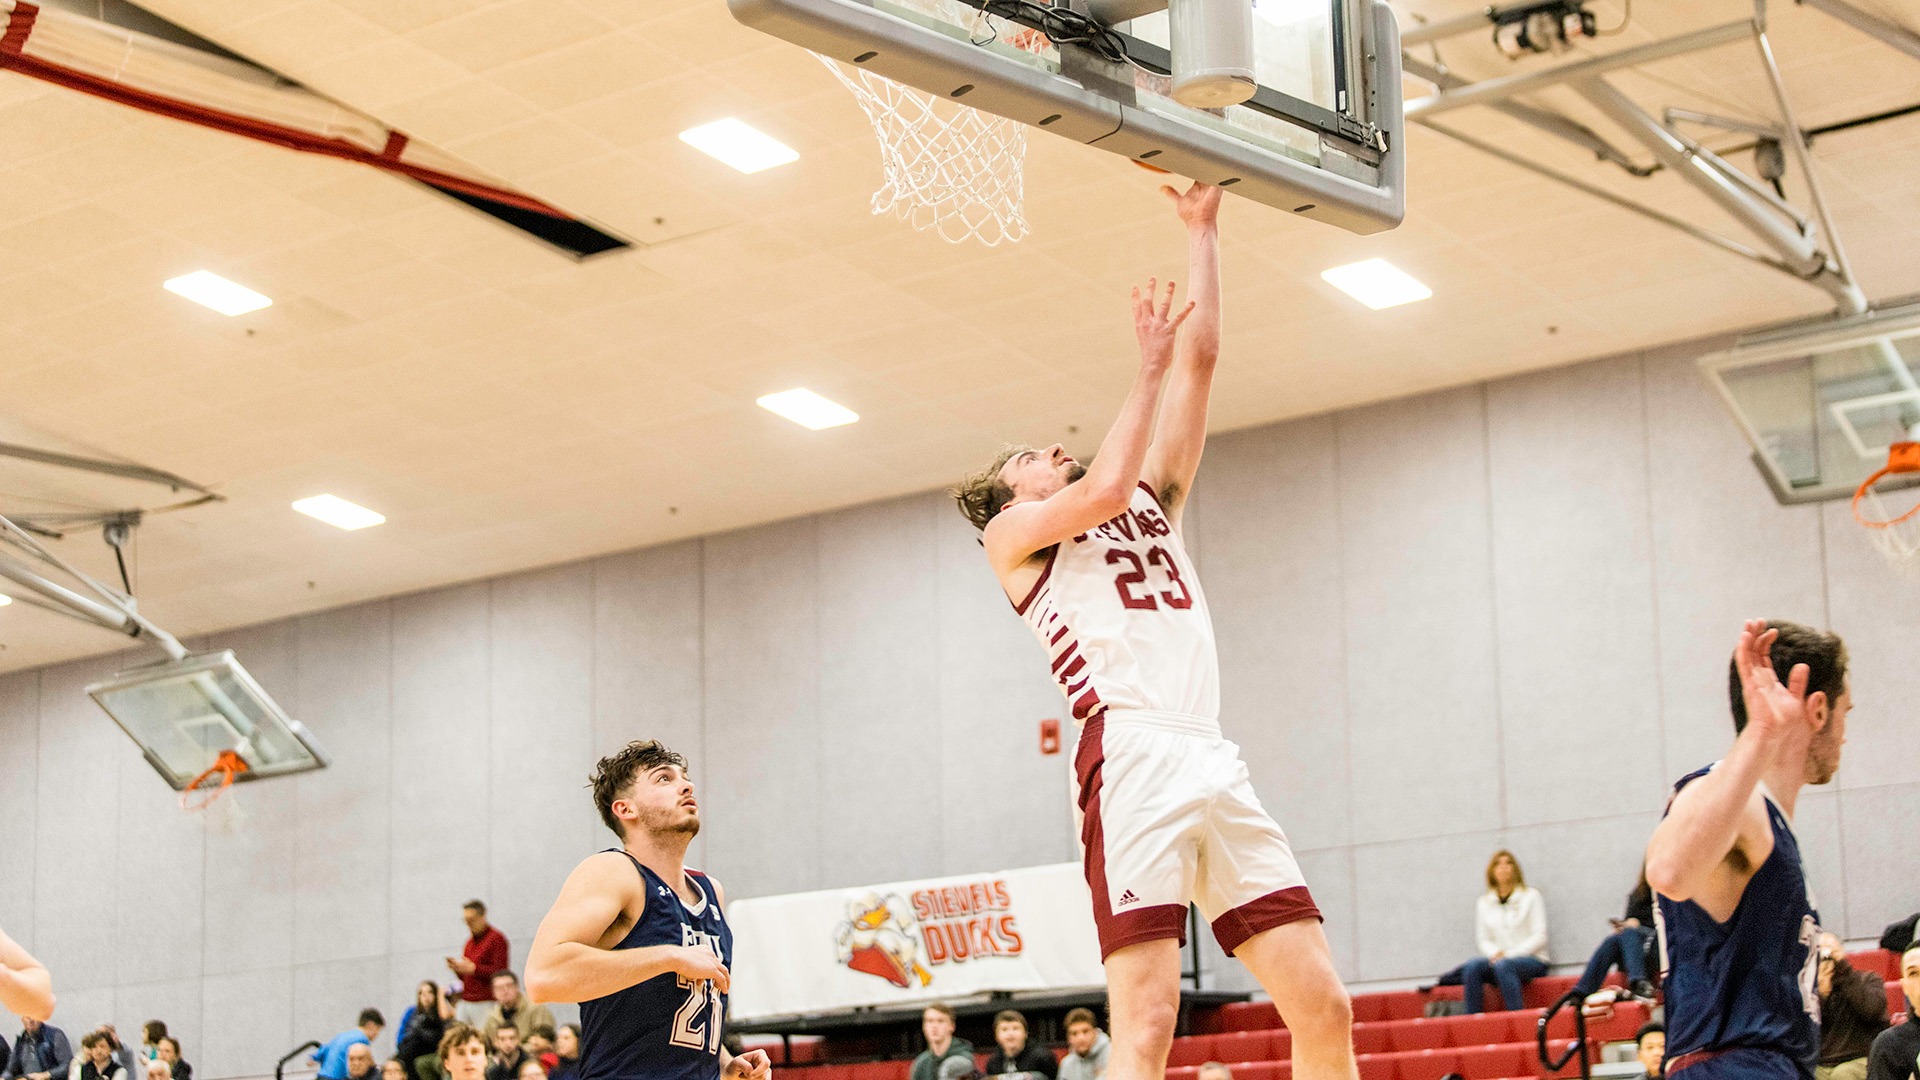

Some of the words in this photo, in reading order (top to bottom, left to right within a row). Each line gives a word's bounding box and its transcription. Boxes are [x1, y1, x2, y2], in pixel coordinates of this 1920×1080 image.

[1105, 545, 1192, 610] 23
[921, 915, 1023, 965] DUCKS
[669, 974, 723, 1055] 21
